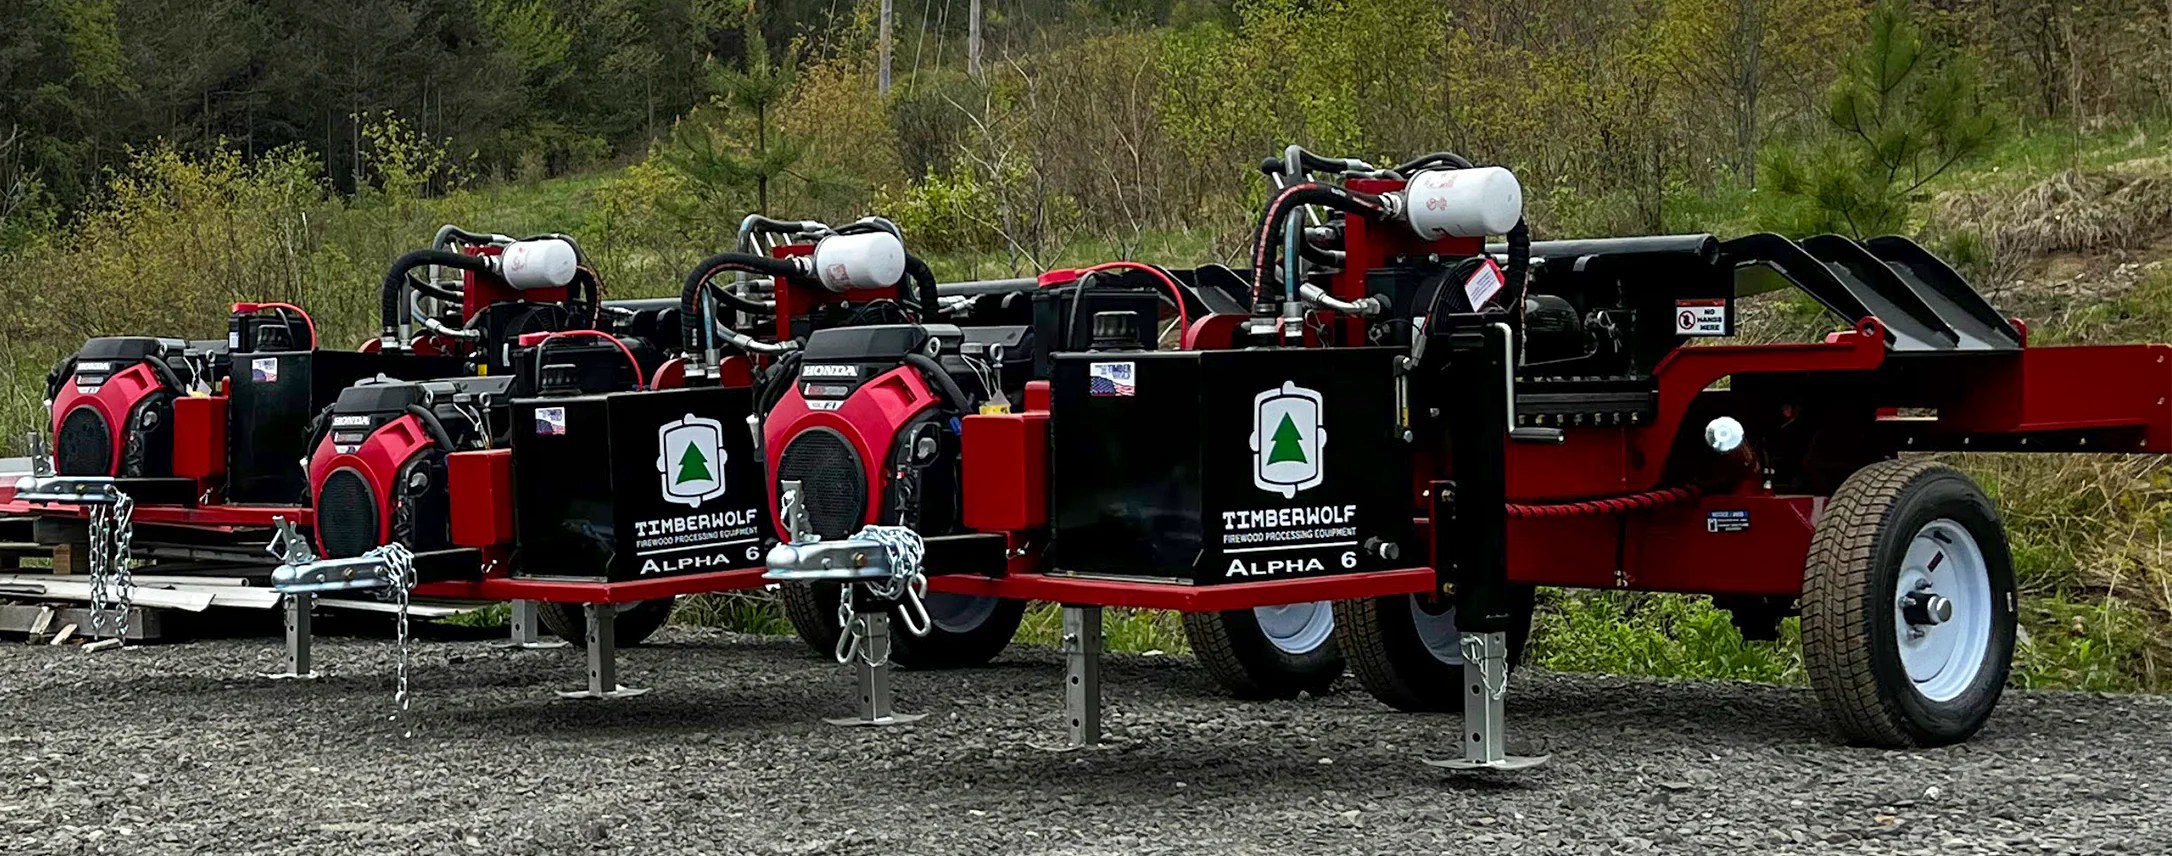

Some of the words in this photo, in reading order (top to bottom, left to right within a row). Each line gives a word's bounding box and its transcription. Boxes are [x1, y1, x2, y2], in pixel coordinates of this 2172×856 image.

[802, 365, 858, 377] HONDA
[333, 415, 370, 426] HONDA
[634, 508, 758, 537] TIMBERWOLF
[1222, 504, 1357, 530] TIMBERWOLF
[636, 536, 674, 548] FIREWOOD
[674, 531, 719, 543] PROCESSING
[719, 526, 758, 539] EQUIPMENT
[1223, 533, 1264, 544] FIREWOOD
[1265, 529, 1313, 541] PROCESSING
[1314, 526, 1357, 539] EQUIPMENT
[745, 546, 760, 560] 6
[1341, 551, 1357, 568] 6
